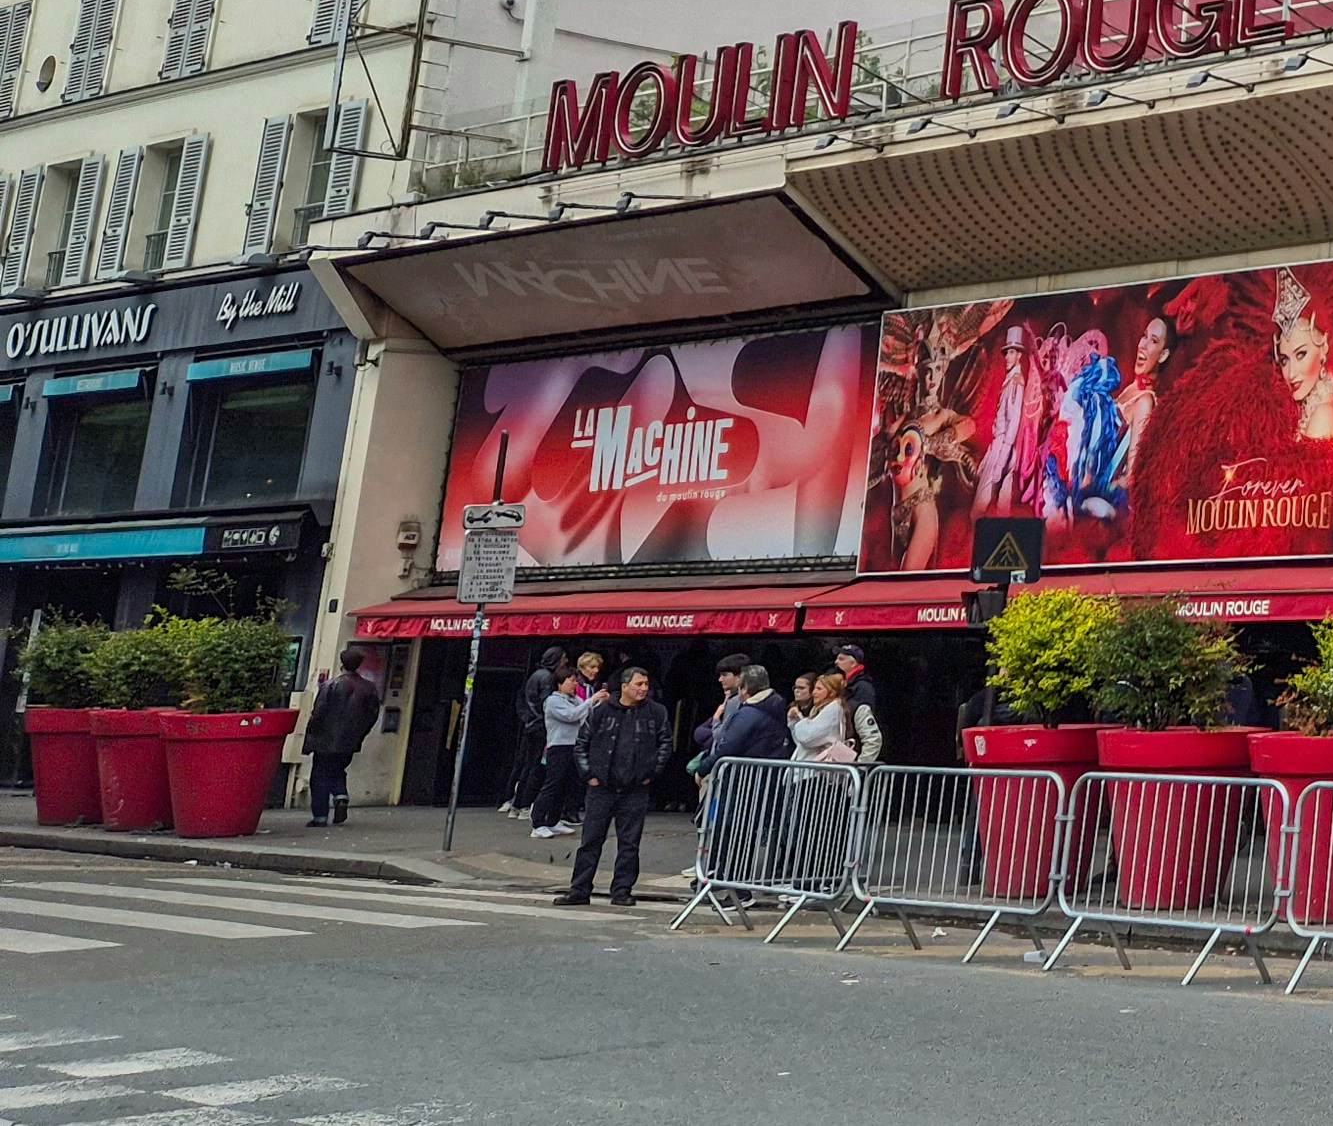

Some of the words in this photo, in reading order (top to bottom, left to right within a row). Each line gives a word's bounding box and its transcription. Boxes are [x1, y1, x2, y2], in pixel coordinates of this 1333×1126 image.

[541, 20, 859, 172] MOULIN
[216, 292, 237, 330] By
[239, 290, 264, 319] the
[264, 282, 300, 318] Mill
[6, 303, 157, 359] O'SULLIVANS
[573, 408, 595, 438] LA
[1211, 458, 1306, 506] Forever
[1186, 495, 1261, 535] MOULIN
[1260, 491, 1333, 530] ROUGE
[626, 615, 661, 628] MOULIN
[662, 615, 694, 628] ROUGE
[917, 607, 960, 622] MOULIN
[1175, 601, 1223, 617] MOULIN
[1226, 599, 1271, 615] ROUGE
